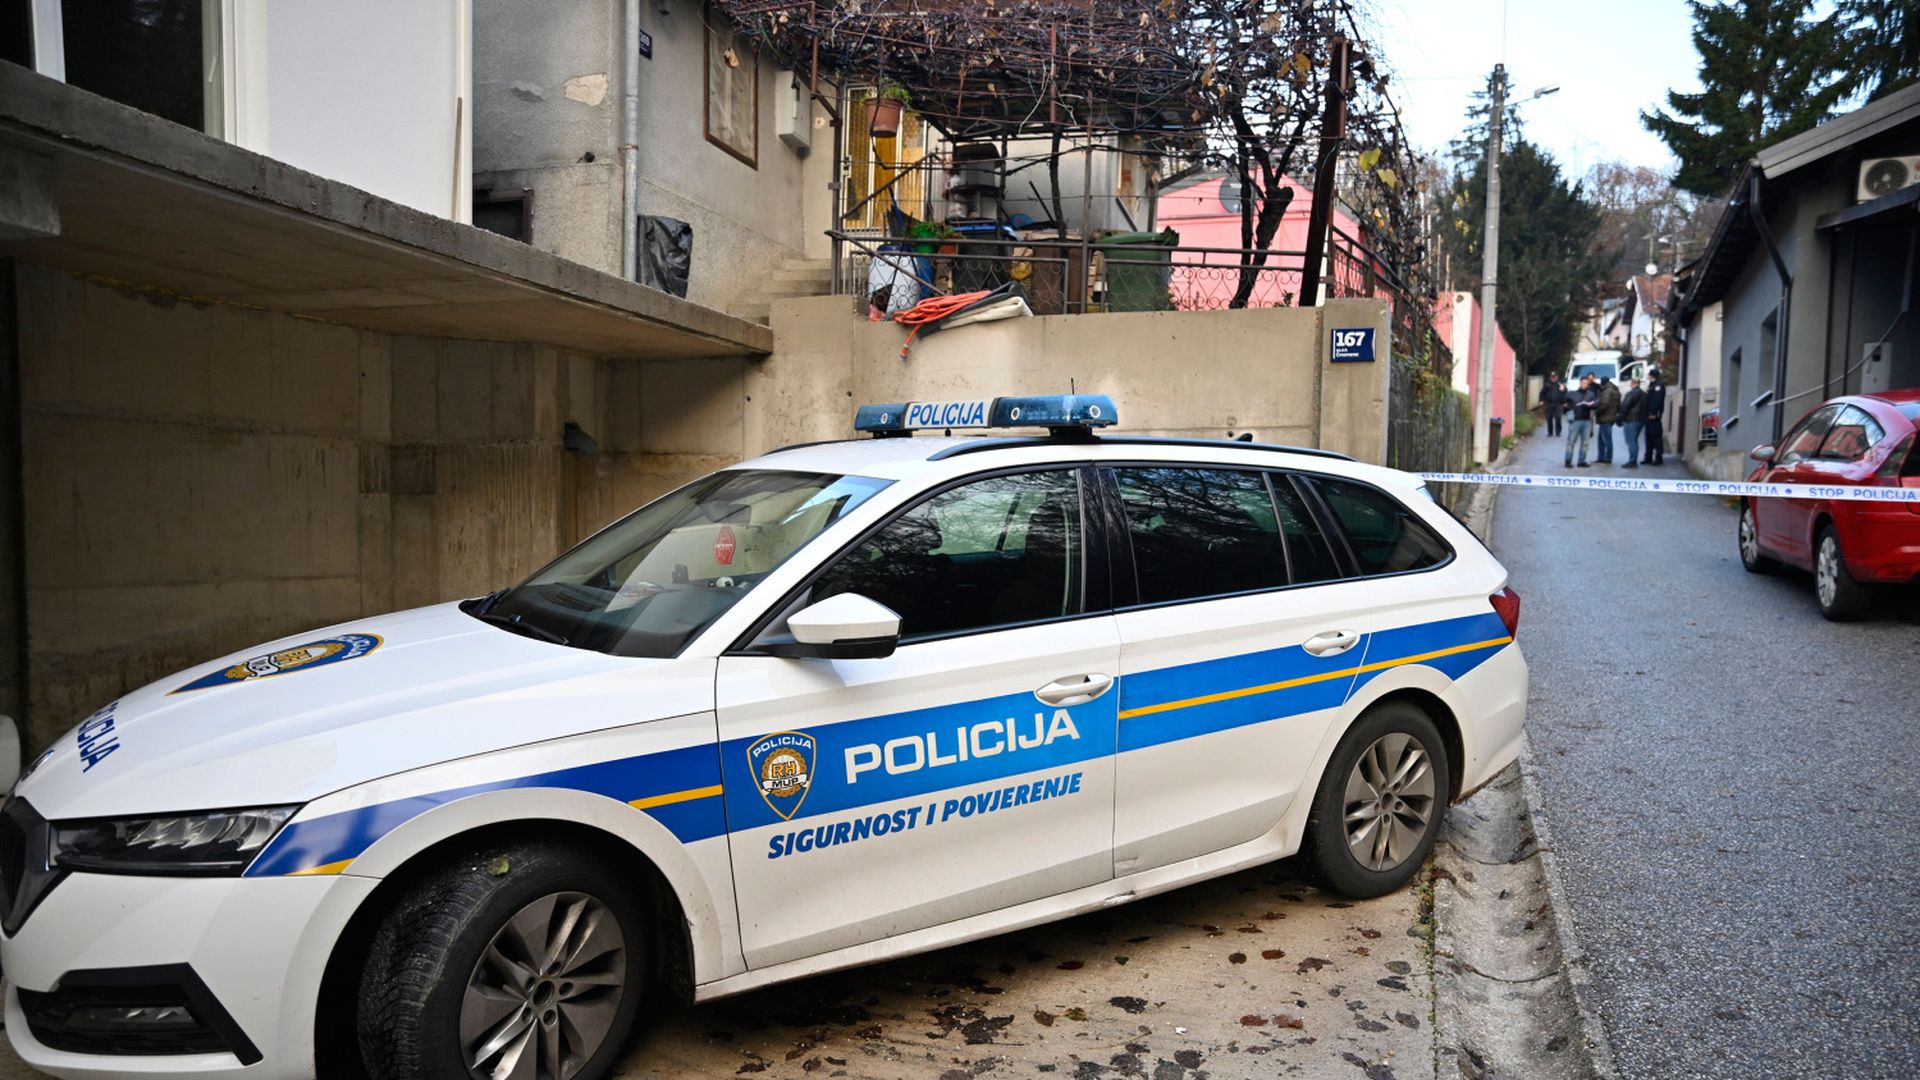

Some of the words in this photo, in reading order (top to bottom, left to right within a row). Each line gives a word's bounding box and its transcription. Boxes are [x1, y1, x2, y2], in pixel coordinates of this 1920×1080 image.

[1336, 331, 1366, 347] 167
[908, 402, 984, 426] POLICIJA
[1462, 474, 1519, 484] POLICIJA
[1547, 477, 1580, 487] STOP
[1589, 479, 1647, 490] POLICIJA
[1676, 482, 1710, 492] STOP
[1719, 484, 1778, 495] POLICIJA
[1809, 487, 1844, 497] STOP
[1853, 489, 1917, 500] POLICIJA
[752, 736, 812, 758] POLICIJA
[844, 708, 1081, 785] POLICIJA
[771, 761, 797, 779] RH
[771, 777, 799, 788] MUP
[767, 806, 923, 860] SIGURNOST
[925, 803, 937, 826] I
[941, 772, 1084, 823] POVJERENJE
